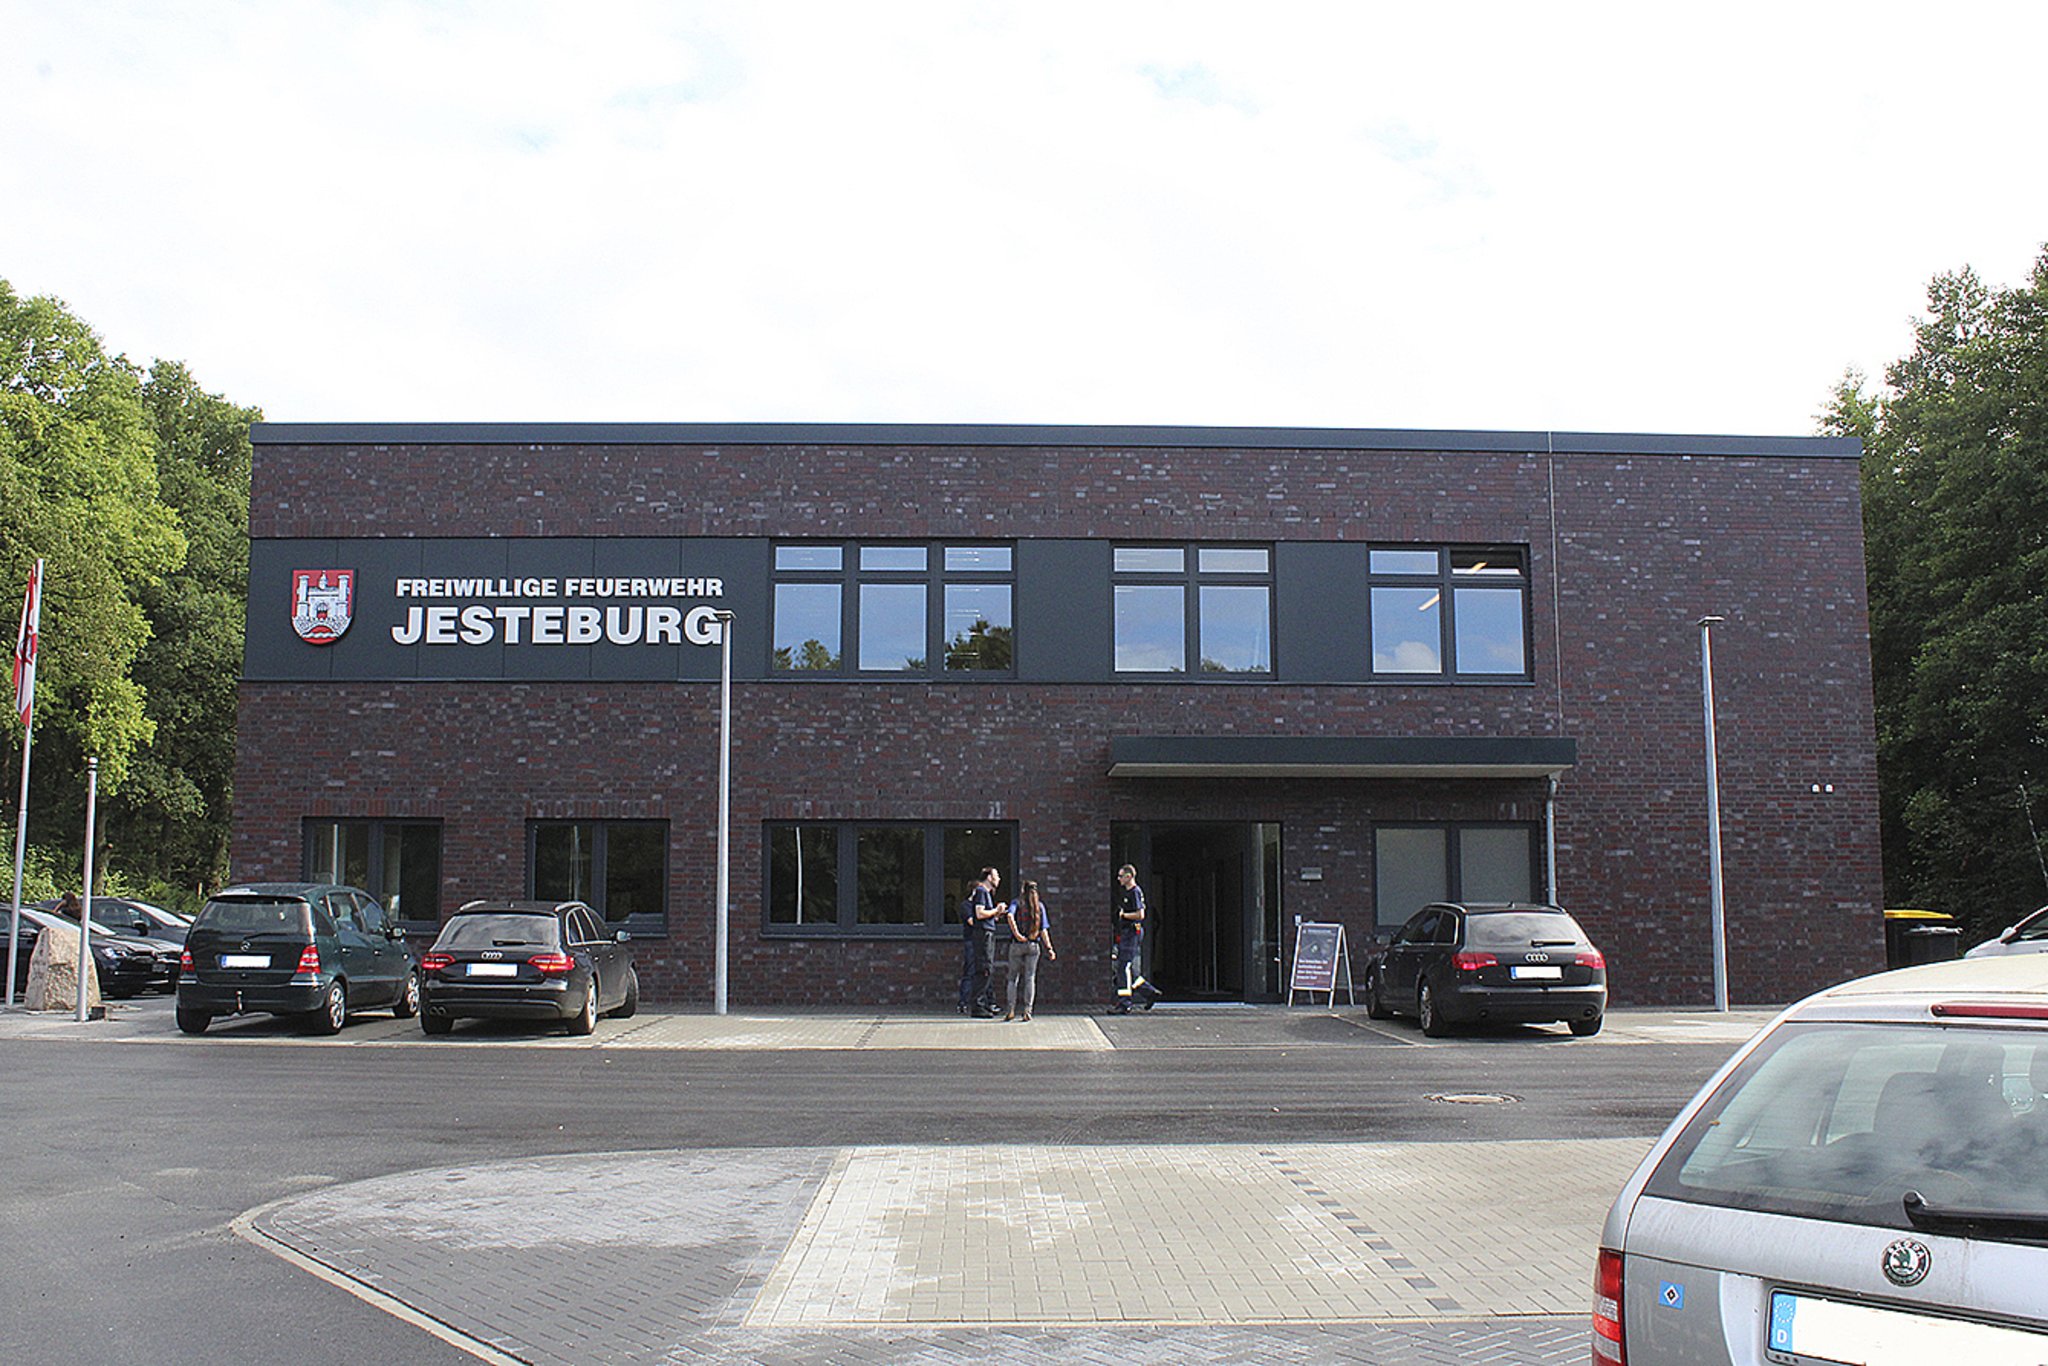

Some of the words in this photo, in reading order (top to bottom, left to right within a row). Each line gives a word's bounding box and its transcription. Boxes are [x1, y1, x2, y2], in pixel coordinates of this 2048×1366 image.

[395, 578, 558, 597] FREIWILLIGE
[564, 577, 723, 597] FEUERWEHR
[391, 605, 722, 645] JESTEBURG
[1777, 1329, 1787, 1343] D
